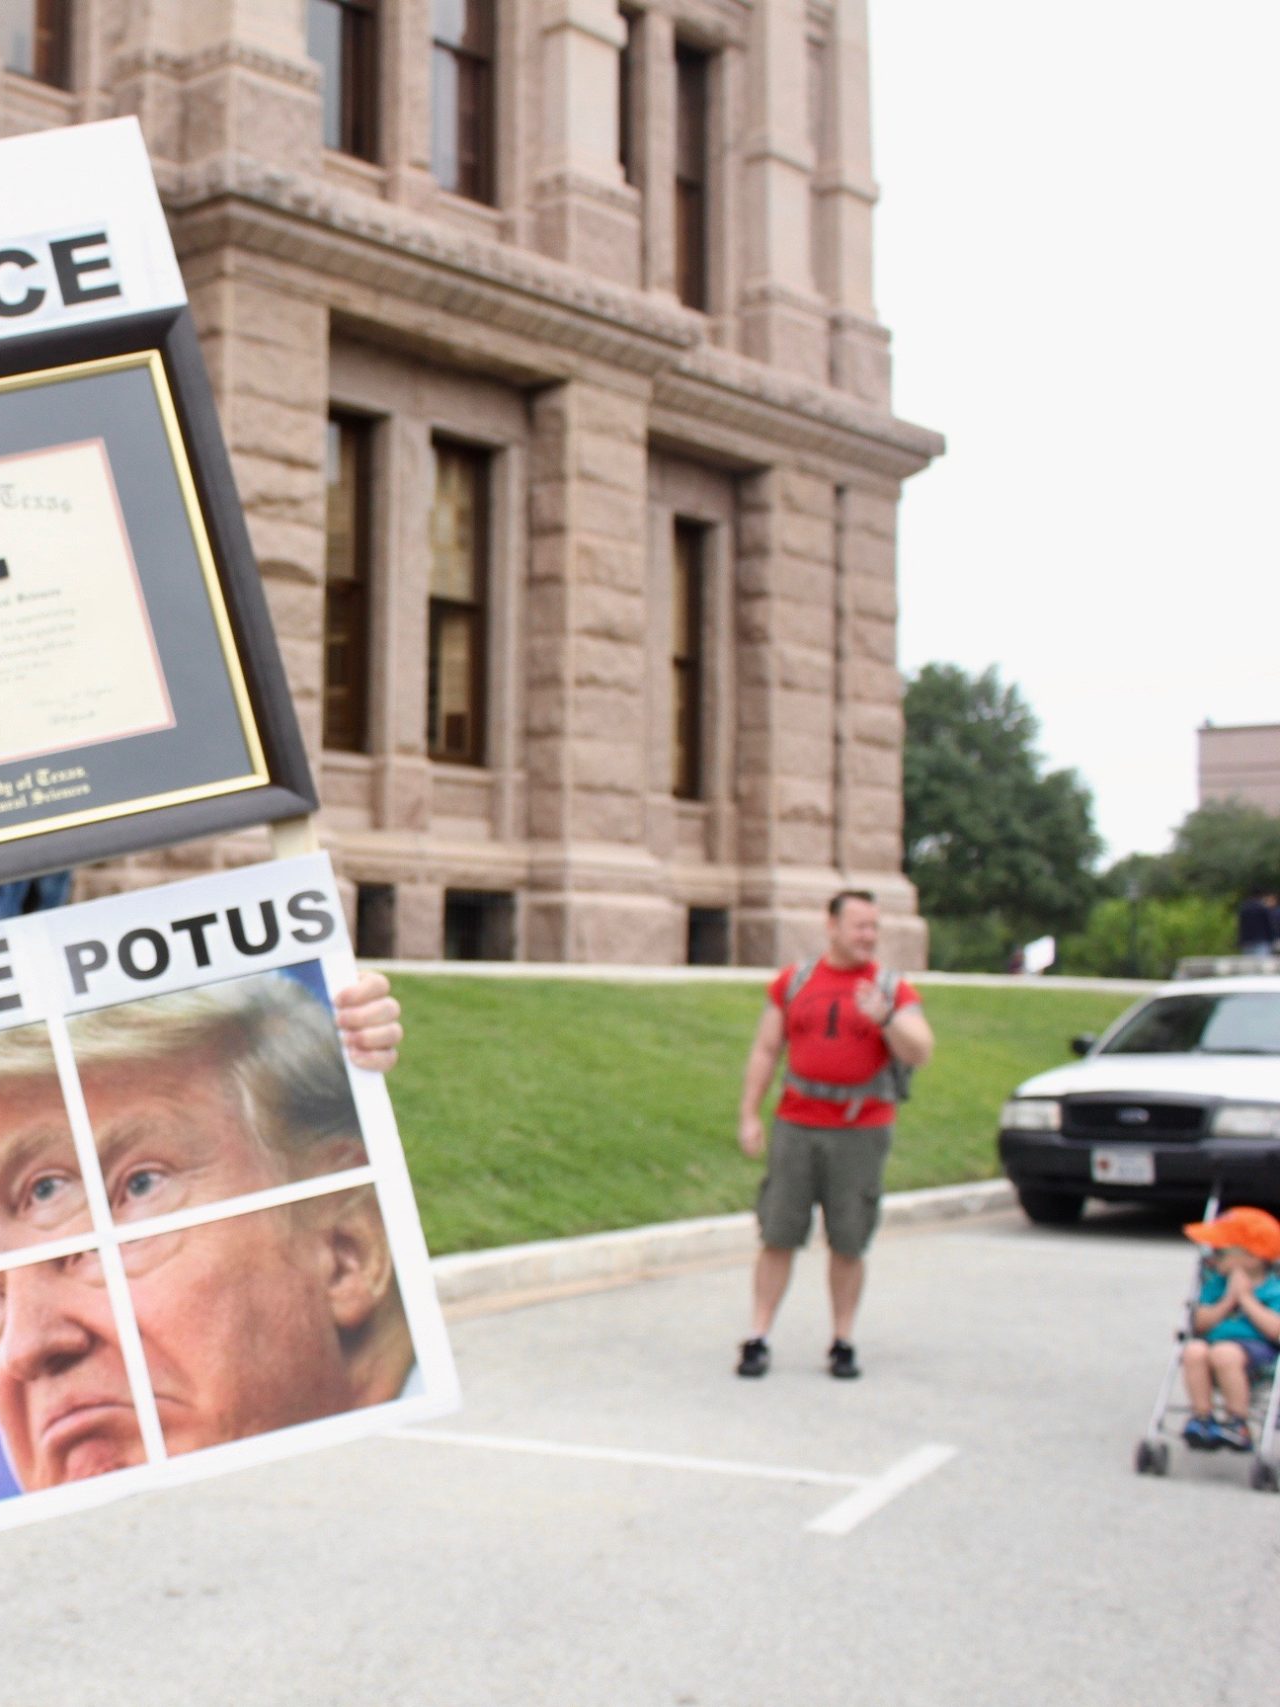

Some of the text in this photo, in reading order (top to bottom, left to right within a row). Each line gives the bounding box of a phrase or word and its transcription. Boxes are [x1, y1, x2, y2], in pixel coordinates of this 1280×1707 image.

[15, 772, 32, 791] of
[35, 765, 87, 787] Texas
[31, 783, 92, 806] Sciences
[65, 890, 336, 996] POTUS
